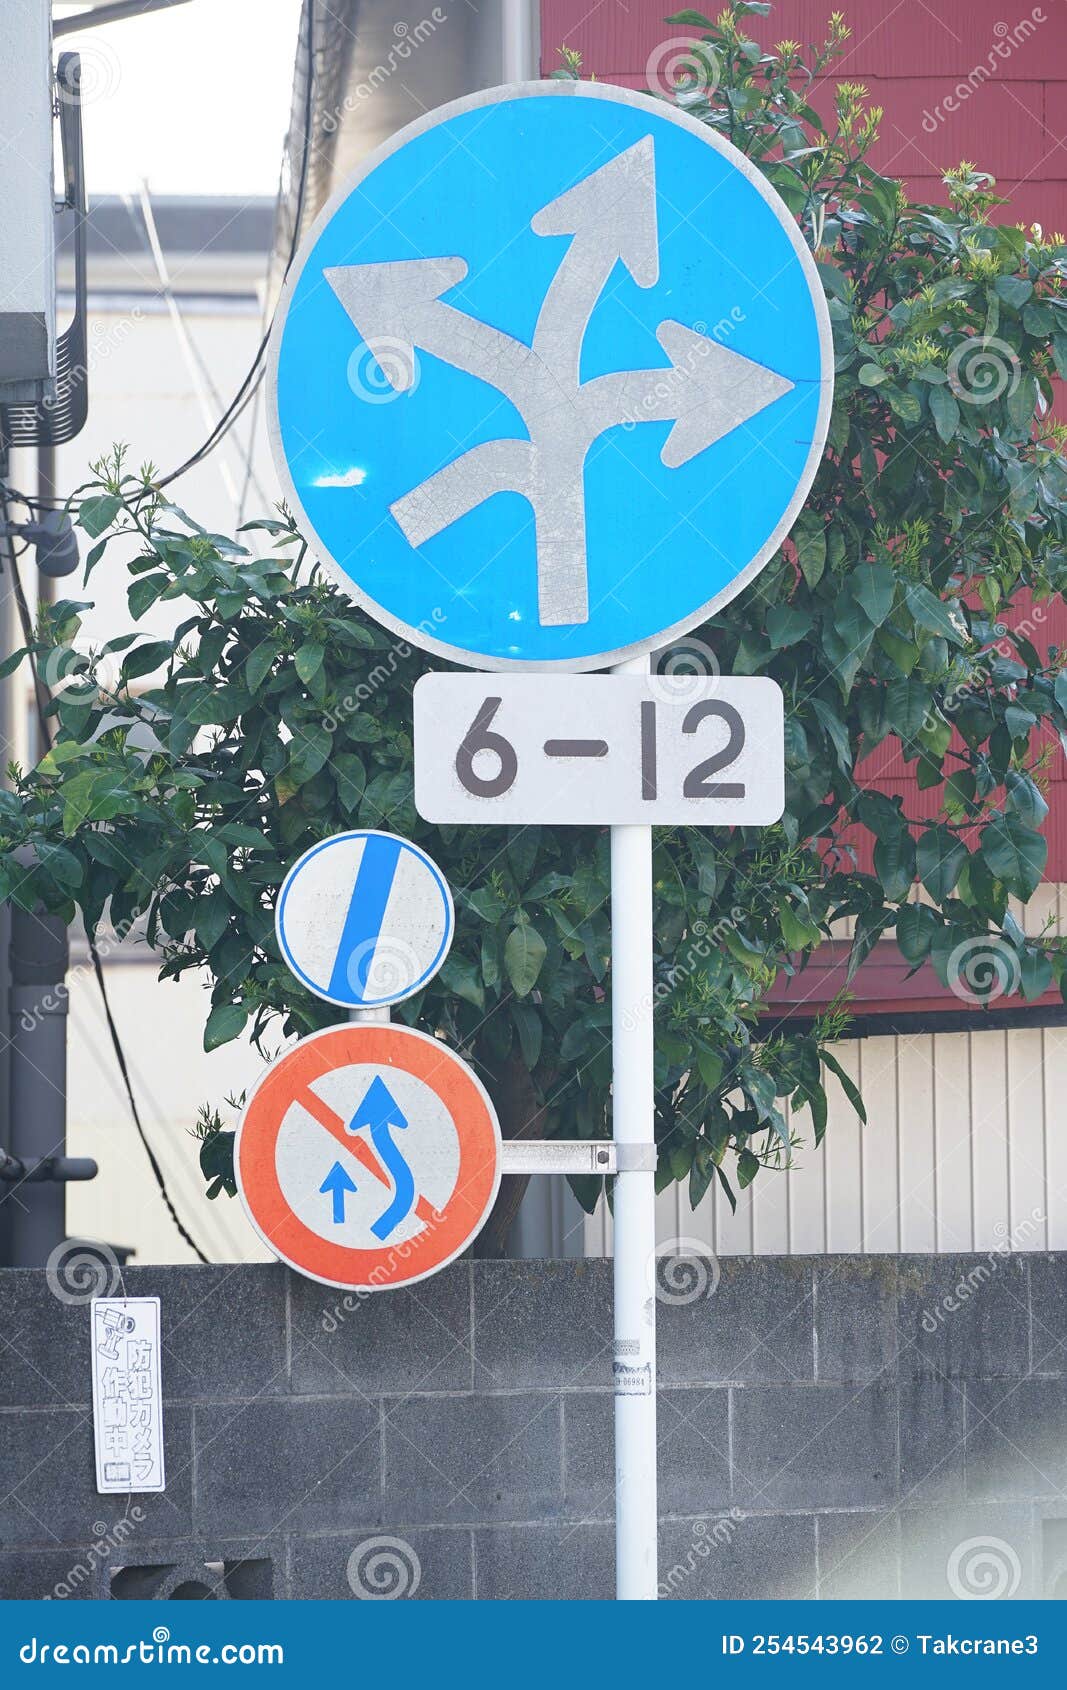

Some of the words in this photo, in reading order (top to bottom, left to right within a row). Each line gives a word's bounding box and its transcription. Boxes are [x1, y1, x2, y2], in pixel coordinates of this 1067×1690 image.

[102, 1367, 129, 1457] 作動中
[127, 1340, 154, 1480] 防犯カメラ
